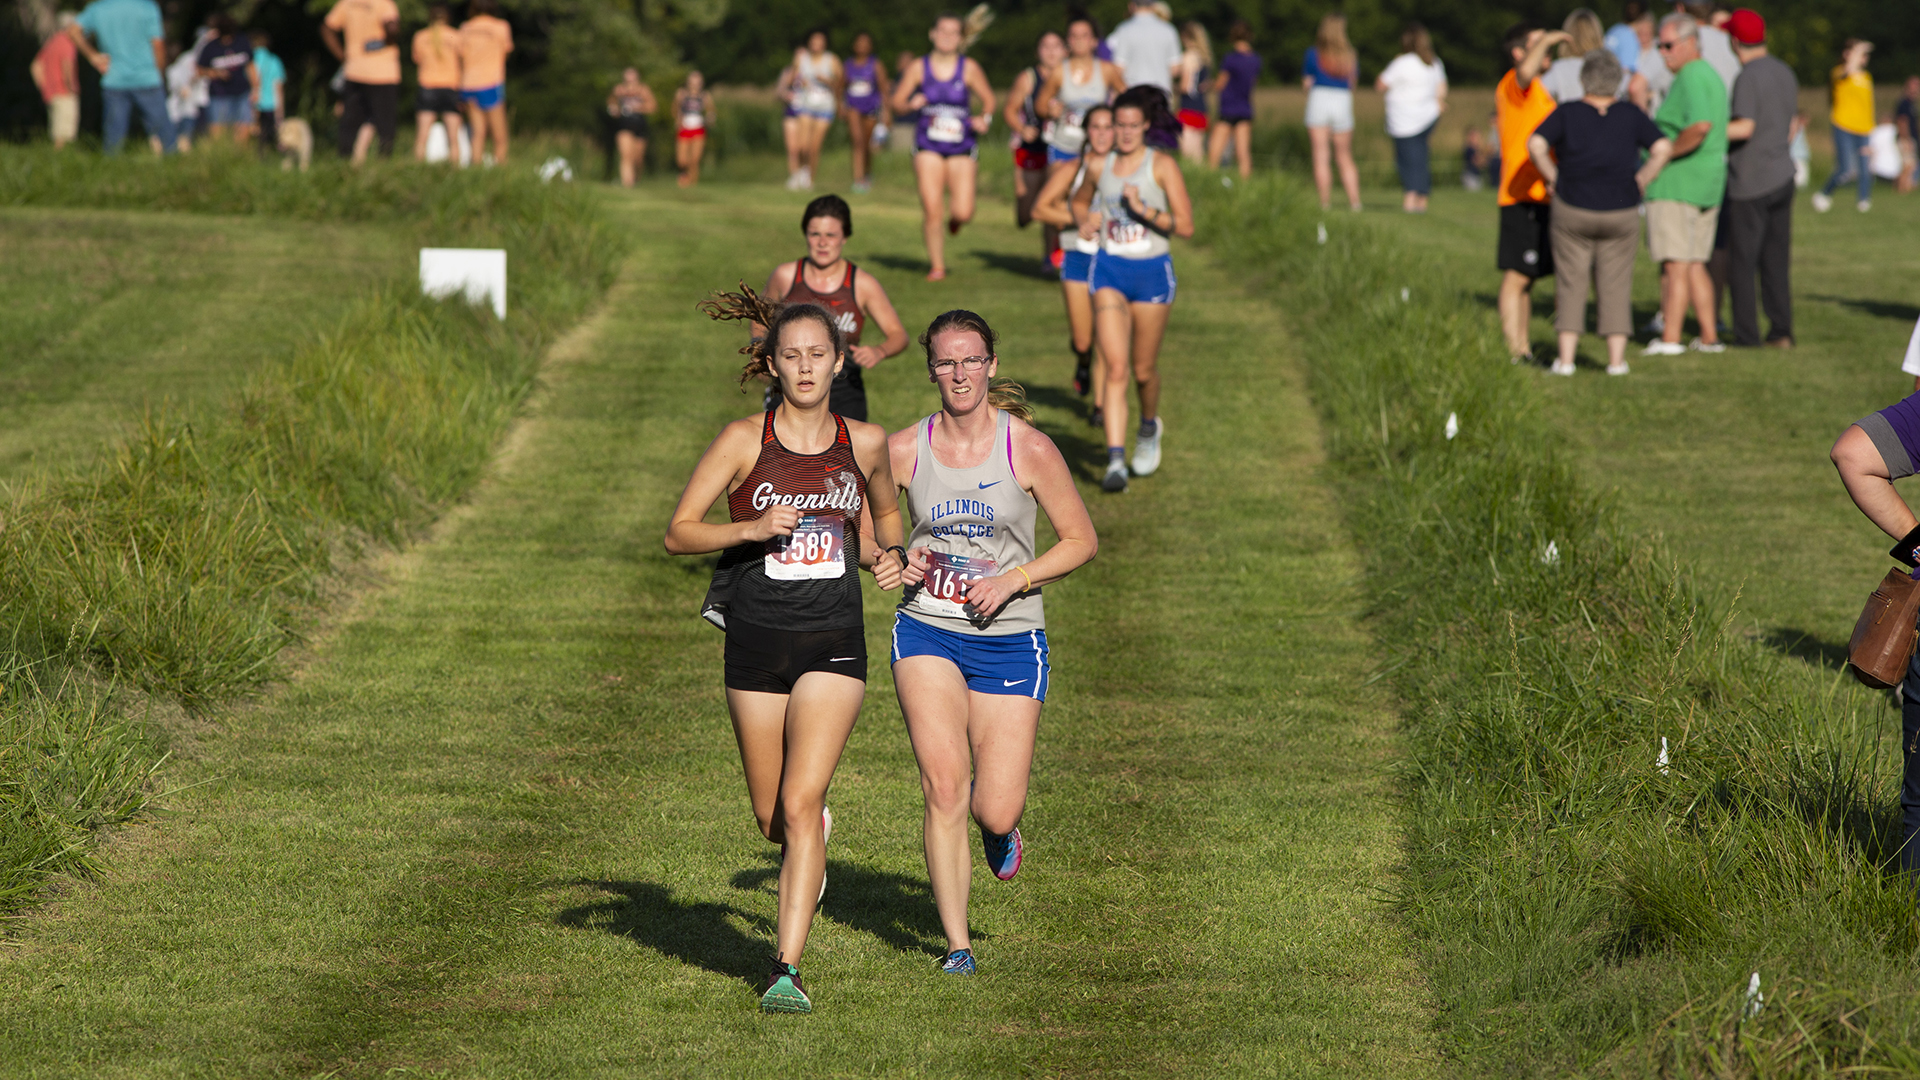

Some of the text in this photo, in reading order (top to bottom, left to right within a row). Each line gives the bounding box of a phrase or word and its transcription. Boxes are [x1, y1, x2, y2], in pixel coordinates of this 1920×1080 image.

[752, 482, 862, 511] Greenville
[931, 499, 994, 522] ILLINOIS
[932, 524, 994, 538] COLLEGE
[777, 531, 833, 561] 1589
[933, 568, 985, 601] 161
